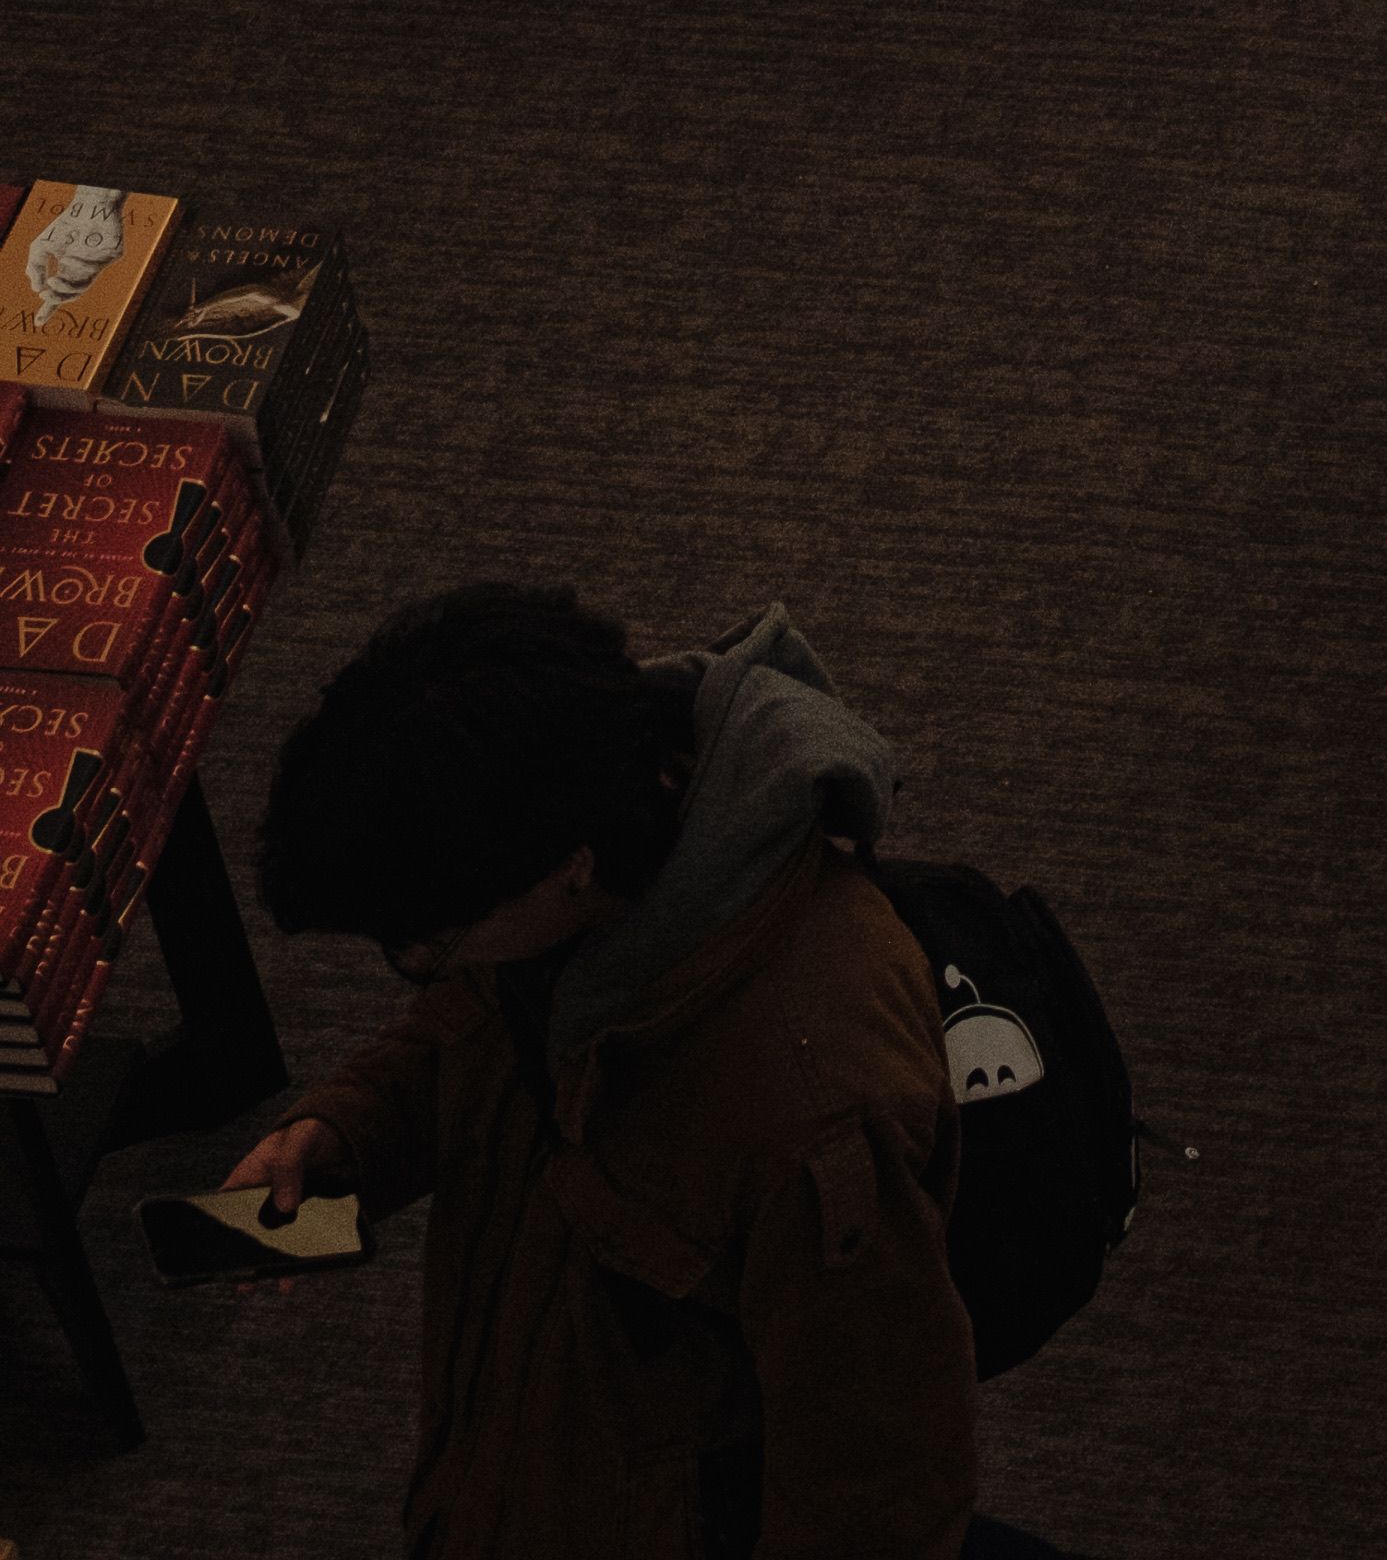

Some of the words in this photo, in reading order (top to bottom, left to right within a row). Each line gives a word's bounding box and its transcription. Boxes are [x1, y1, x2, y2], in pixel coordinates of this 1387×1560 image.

[138, 337, 276, 371] BROWN
[119, 371, 260, 410] DAN
[30, 433, 195, 470] SECRETS
[7, 487, 162, 526] SECRET
